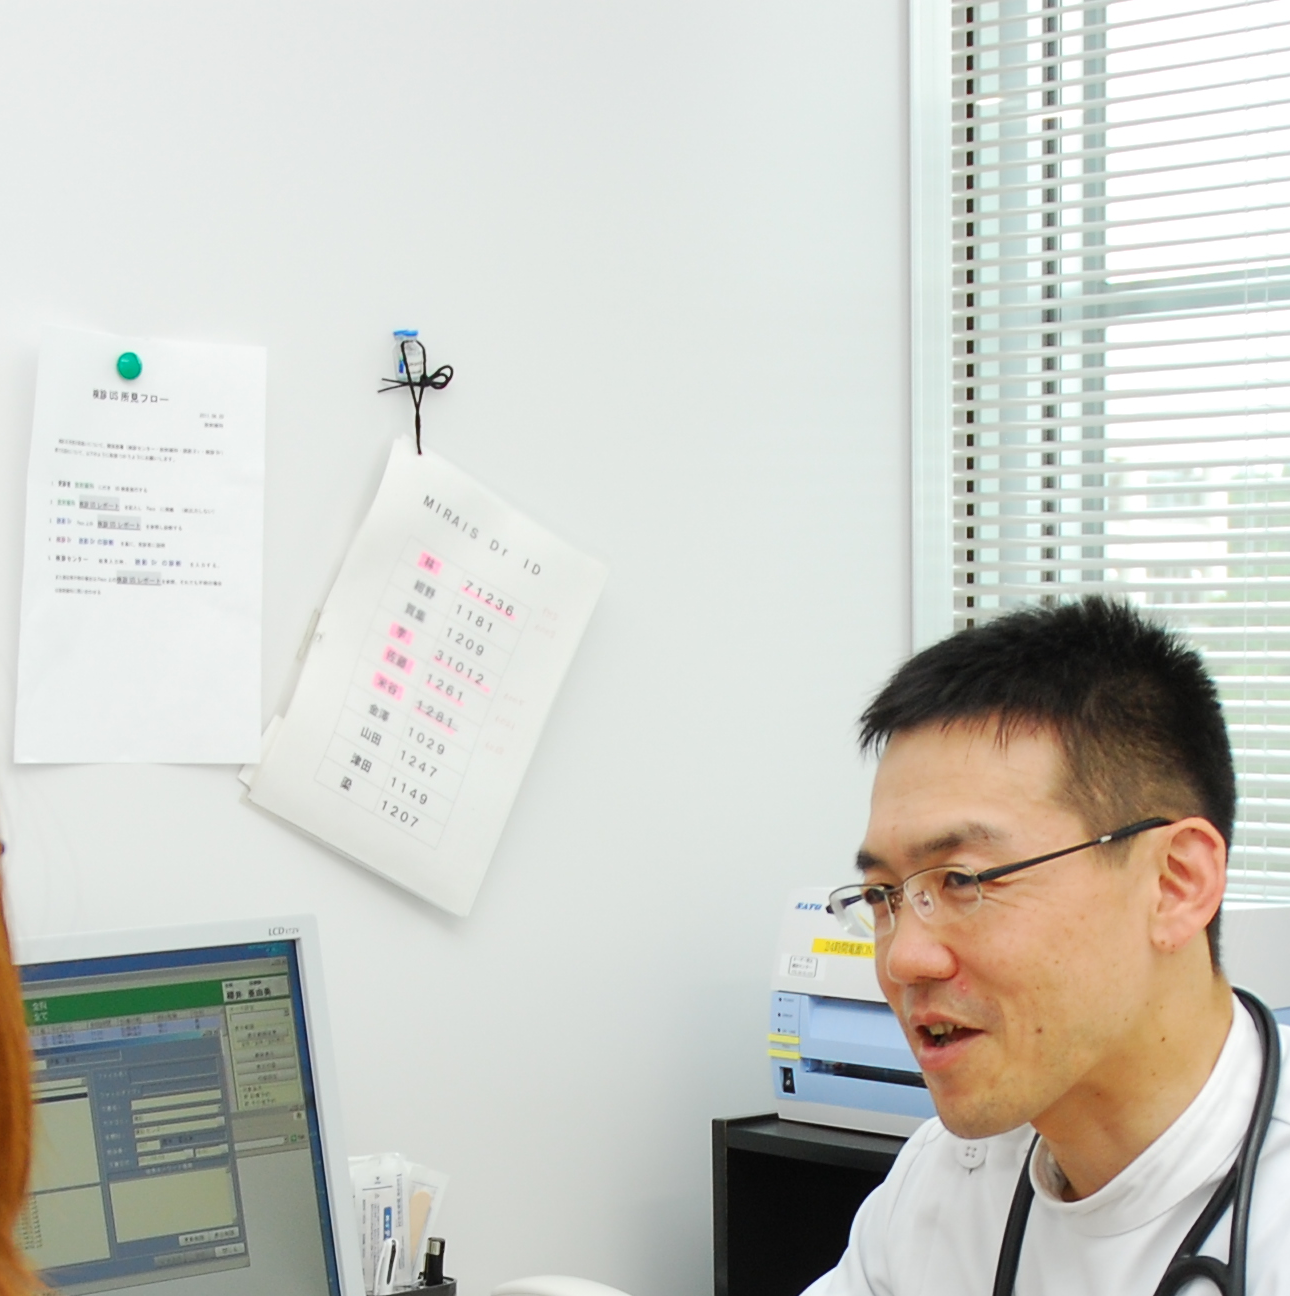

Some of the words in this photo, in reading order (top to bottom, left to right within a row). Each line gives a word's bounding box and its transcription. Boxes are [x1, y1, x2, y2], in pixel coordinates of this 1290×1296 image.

[423, 495, 480, 540] MIRAIS
[489, 539, 509, 557] Dr
[523, 558, 542, 577] ID
[464, 580, 515, 618] 71236
[455, 603, 494, 634] 1181
[445, 627, 485, 657] 1209
[434, 649, 486, 687] 31012
[426, 674, 465, 703] 1261
[359, 726, 383, 747] 山田
[399, 750, 438, 779] 1247
[407, 727, 446, 756] 1029
[390, 777, 429, 806] 1149
[381, 800, 420, 830] 1207
[268, 926, 285, 936] LCD
